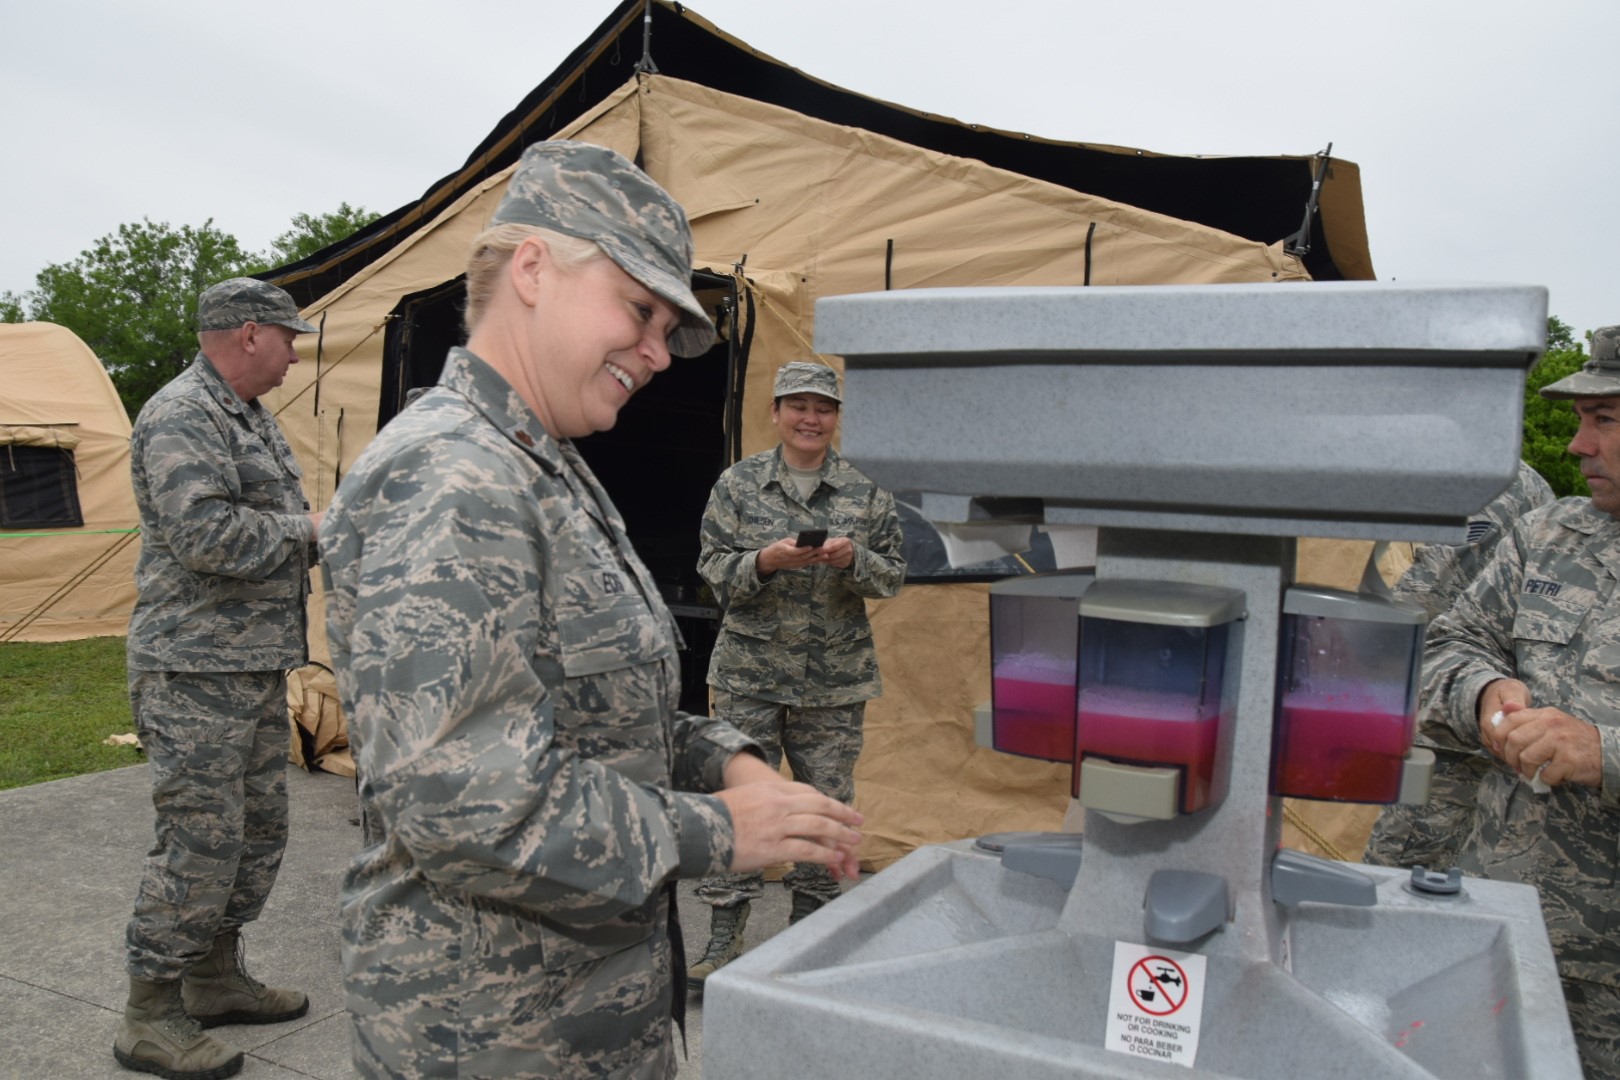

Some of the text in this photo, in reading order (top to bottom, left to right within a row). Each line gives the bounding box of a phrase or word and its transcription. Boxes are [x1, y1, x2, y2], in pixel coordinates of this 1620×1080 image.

[1525, 579, 1562, 597] PETRI
[1116, 1013, 1191, 1034] NOT FOR DRINKING
[1127, 1023, 1178, 1040] OR COOKING
[1120, 1034, 1183, 1053] NO PARA BEBER
[1137, 1045, 1172, 1059] COCINAR
